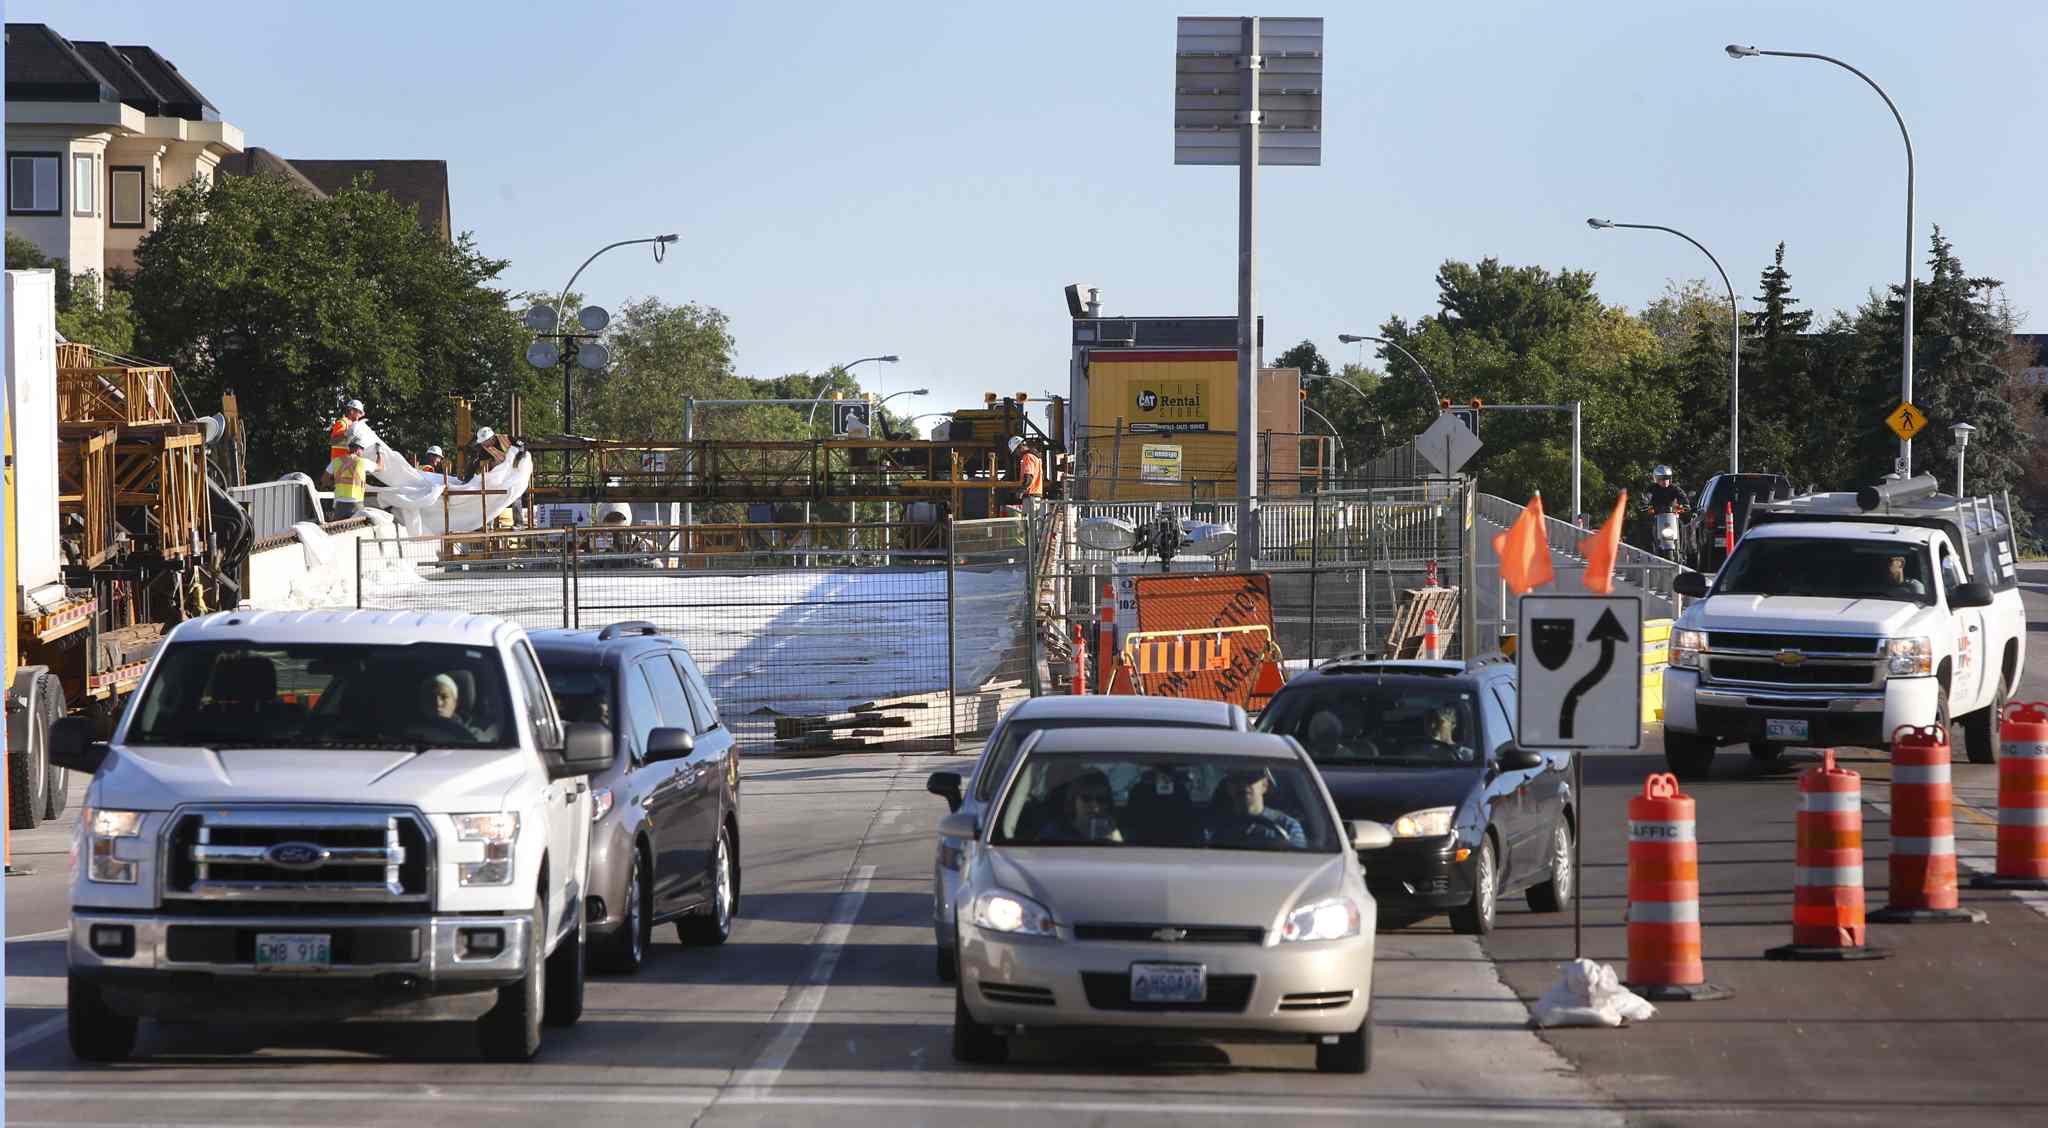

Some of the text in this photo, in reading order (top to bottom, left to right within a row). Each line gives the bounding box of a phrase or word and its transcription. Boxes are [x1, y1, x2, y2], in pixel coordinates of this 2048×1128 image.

[1160, 396, 1200, 407] Rental
[1119, 599, 1137, 609] 102
[1632, 824, 1678, 838] AFFIC
